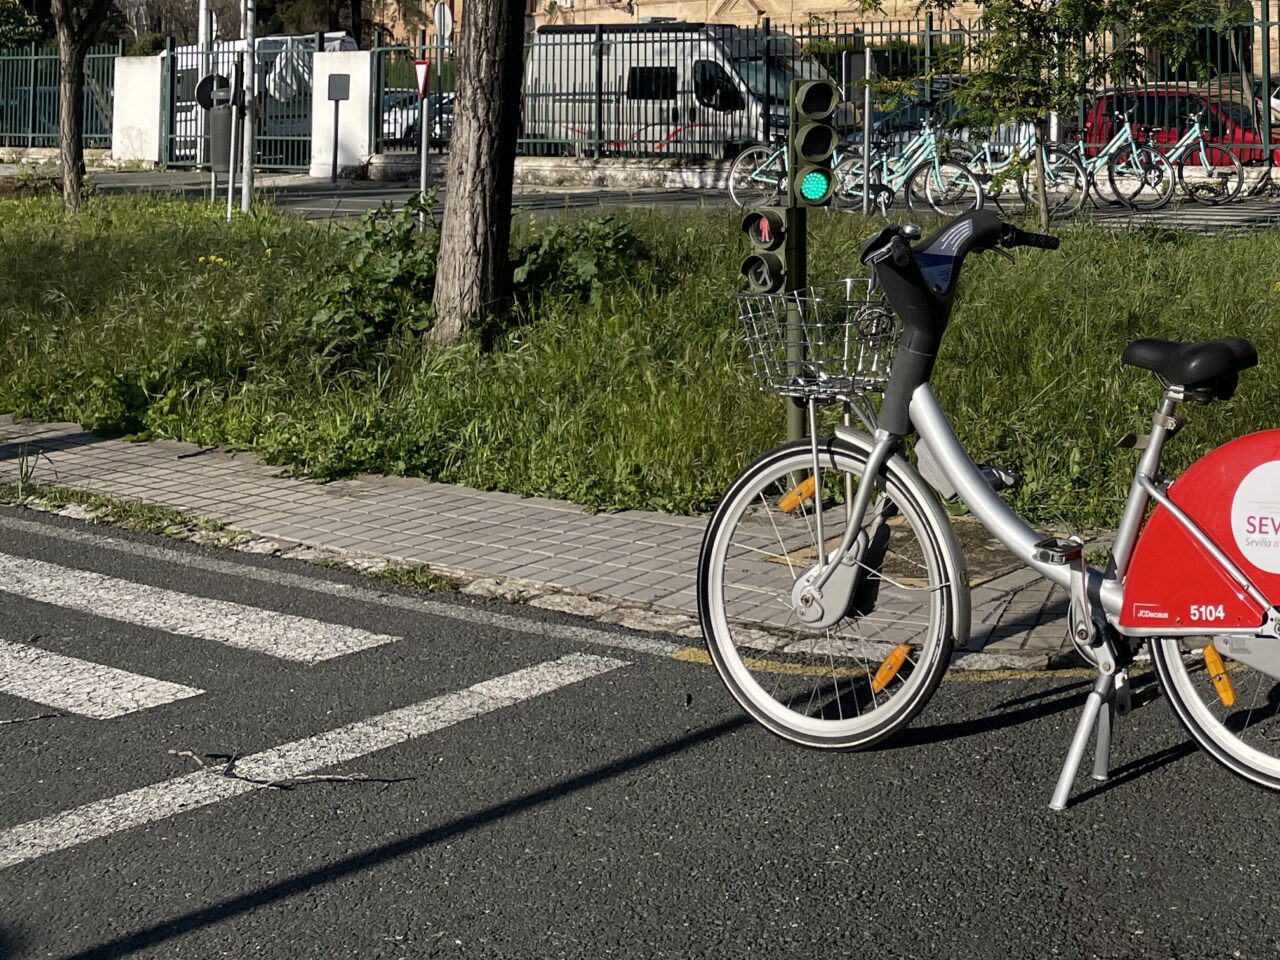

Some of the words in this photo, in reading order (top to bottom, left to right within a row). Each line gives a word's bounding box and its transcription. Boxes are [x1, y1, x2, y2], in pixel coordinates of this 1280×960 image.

[1245, 537, 1272, 548] Sevilla
[1137, 609, 1169, 619] JCDecaux
[1190, 604, 1225, 621] 5104
